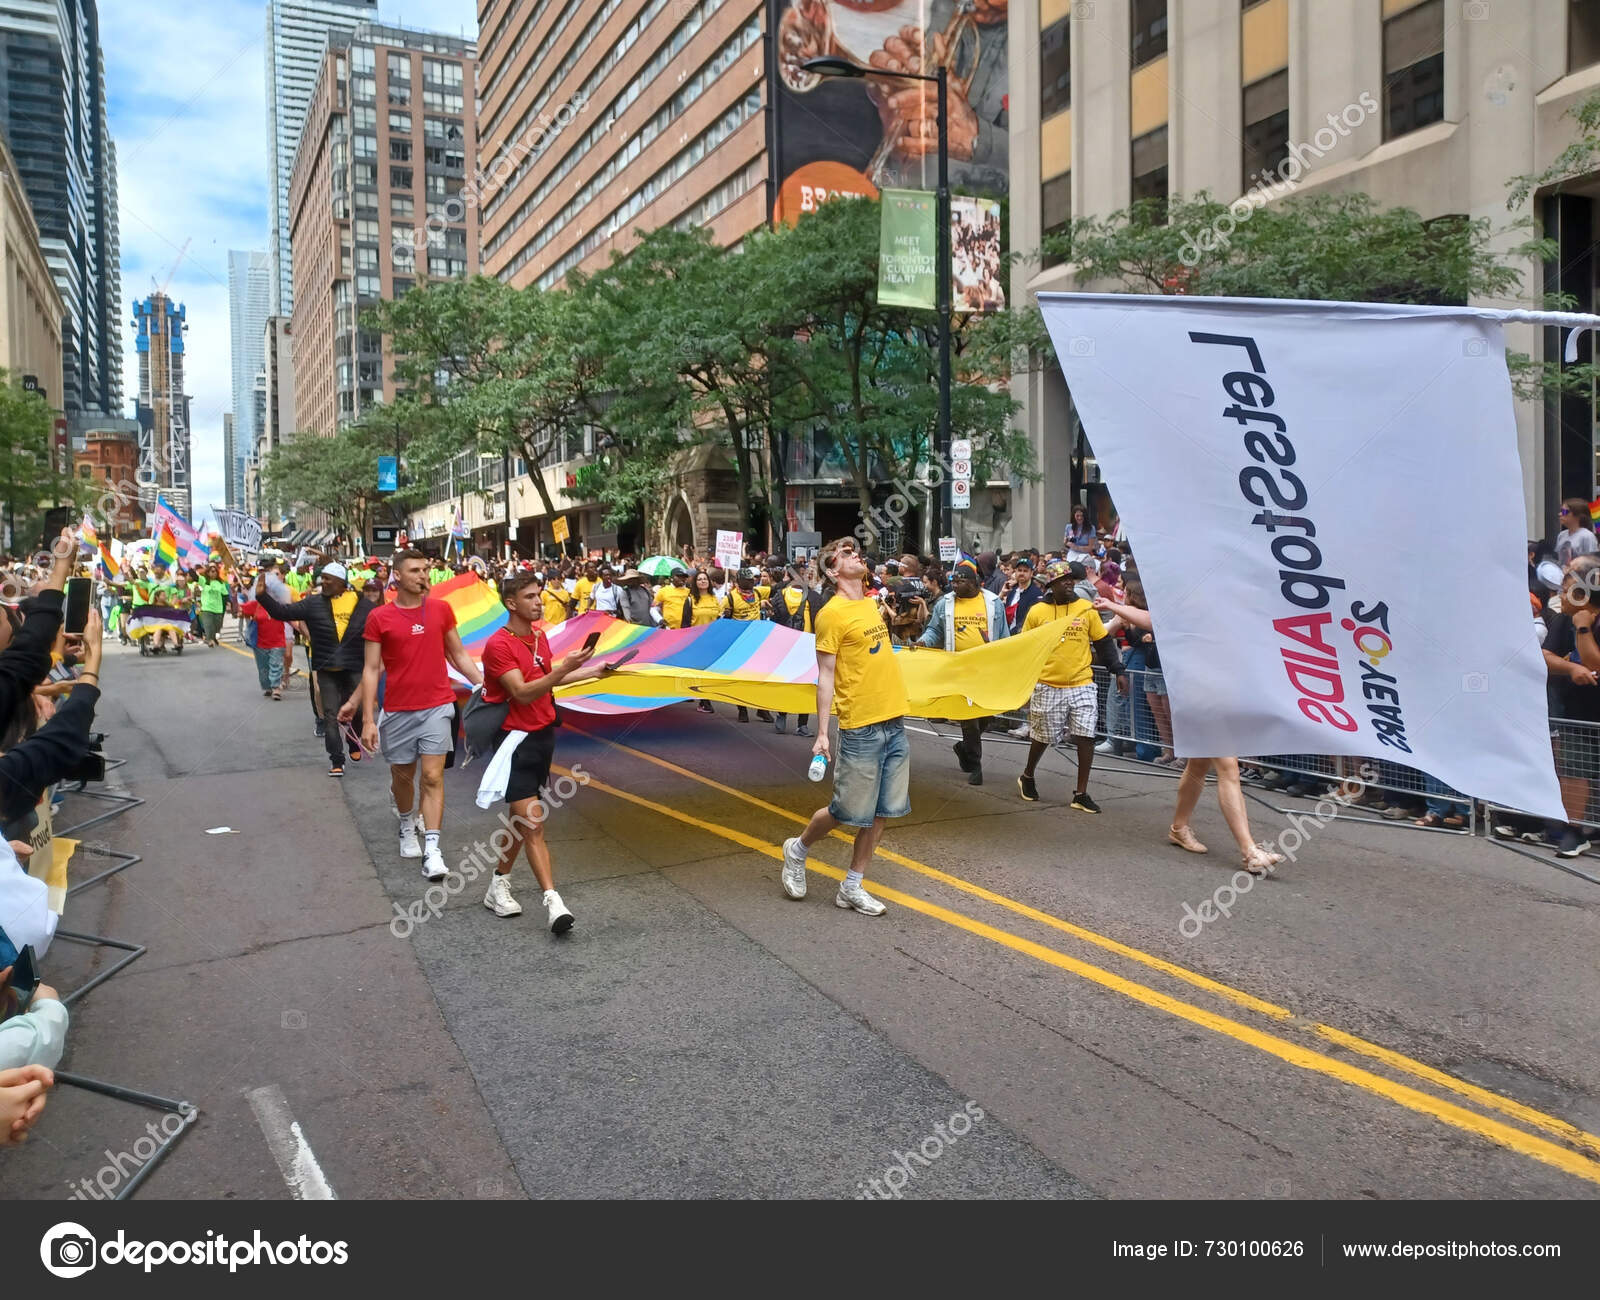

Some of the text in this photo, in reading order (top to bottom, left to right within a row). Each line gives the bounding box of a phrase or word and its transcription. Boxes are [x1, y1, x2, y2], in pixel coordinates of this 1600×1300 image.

[895, 236, 920, 246] MEET
[908, 247, 920, 256] IN
[883, 274, 916, 284] HEART
